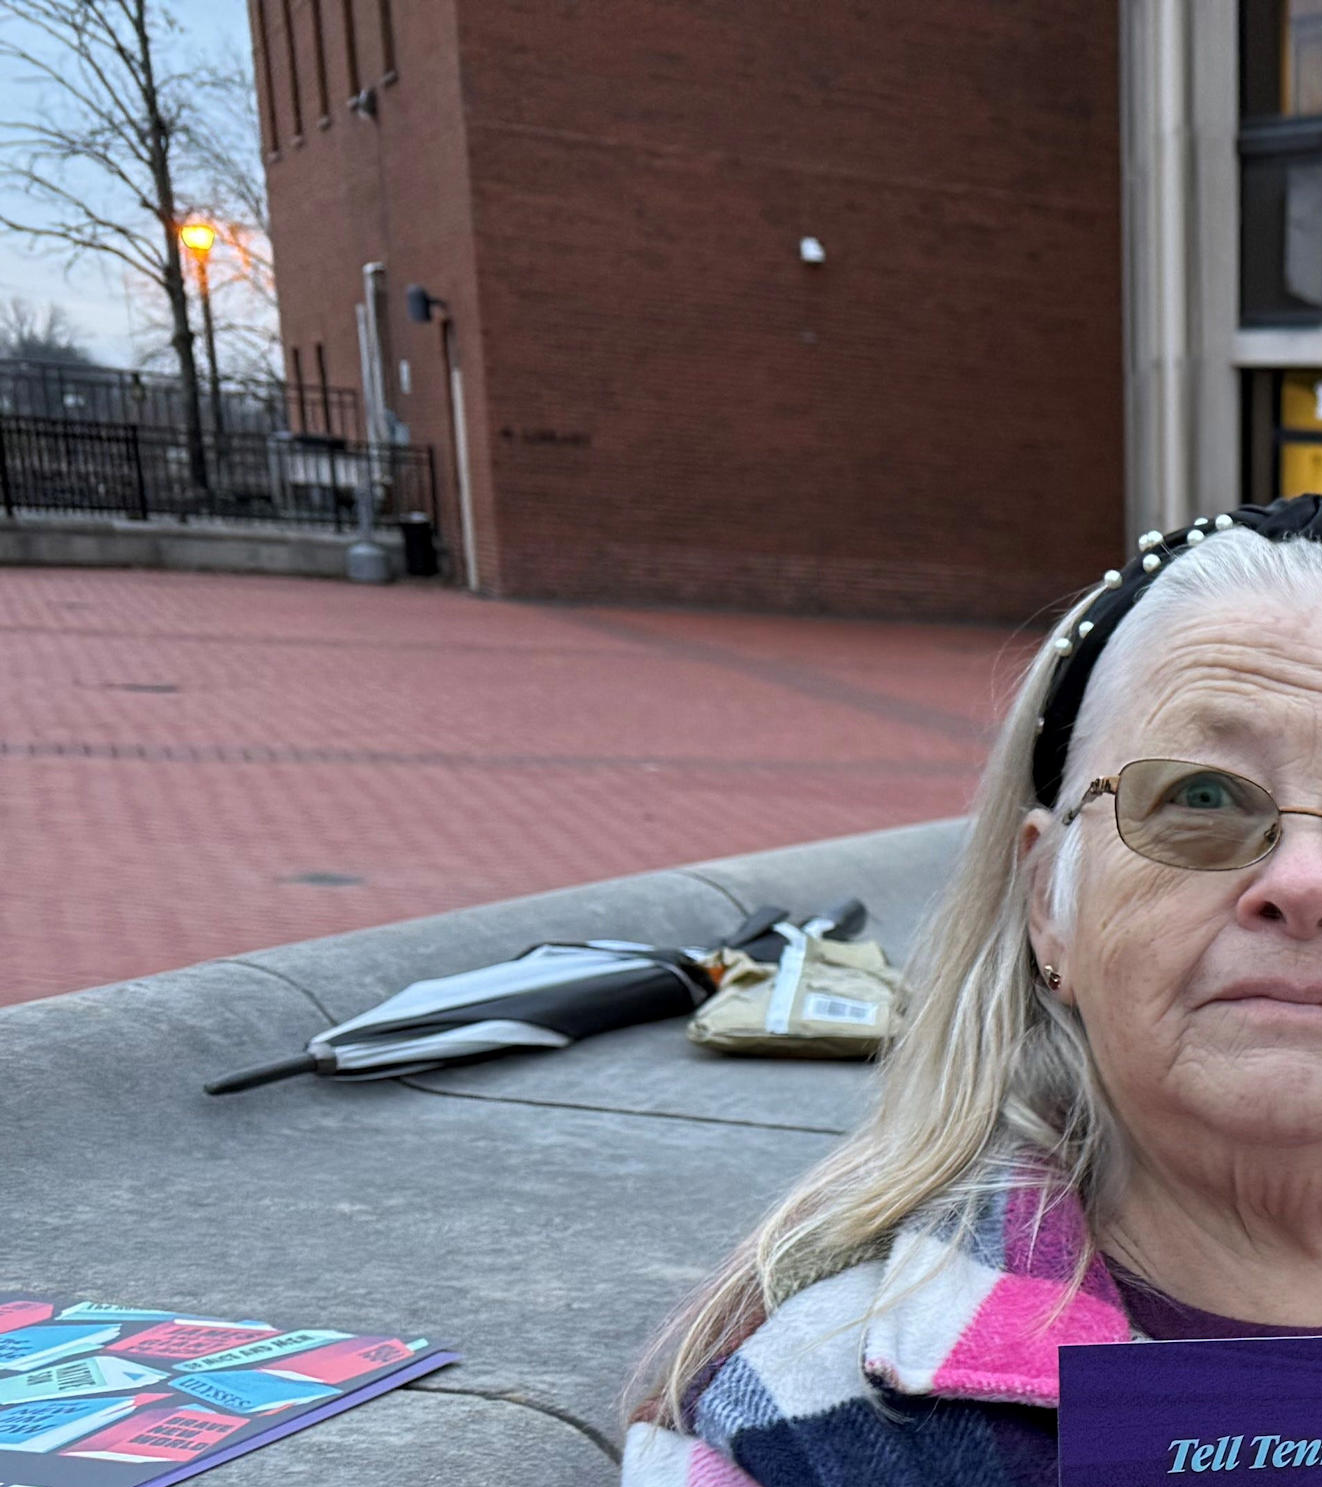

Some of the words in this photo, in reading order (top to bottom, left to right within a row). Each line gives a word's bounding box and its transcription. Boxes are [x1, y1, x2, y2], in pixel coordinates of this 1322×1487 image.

[178, 1377, 253, 1408] ULYSSES
[146, 1425, 202, 1439] NEW
[163, 1416, 235, 1433] BRAVE
[128, 1434, 210, 1451] WORLD
[1168, 1434, 1243, 1474] Tell
